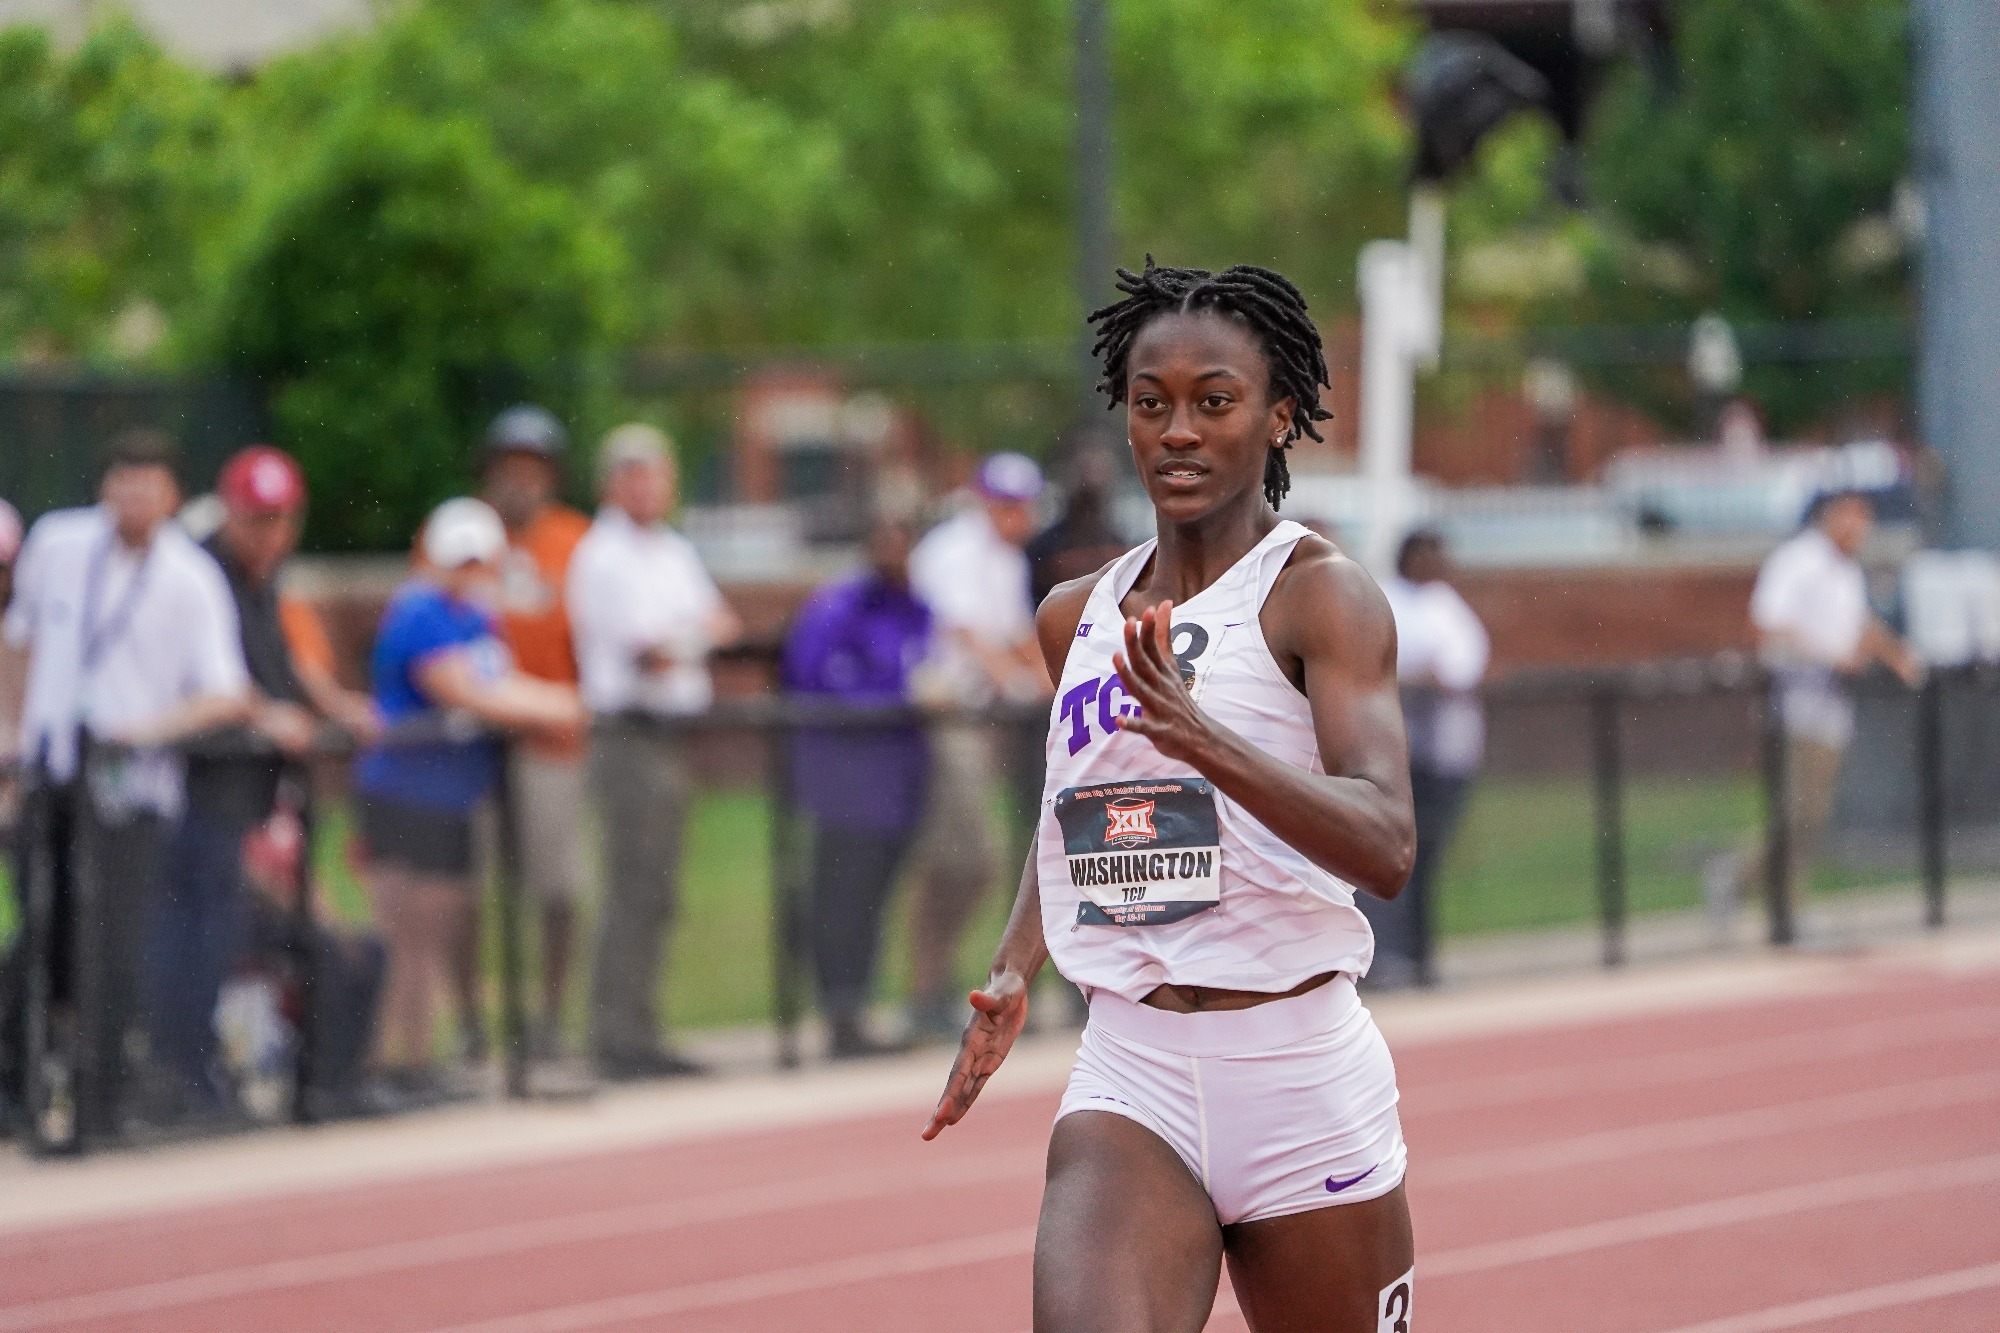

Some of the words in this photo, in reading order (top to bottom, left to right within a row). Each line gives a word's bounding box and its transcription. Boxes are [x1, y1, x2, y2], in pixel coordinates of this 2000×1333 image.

[1060, 673, 1142, 757] TC
[1069, 851, 1212, 887] WASHINGTON
[1122, 887, 1147, 903] TCU
[1385, 1283, 1410, 1333] 3
